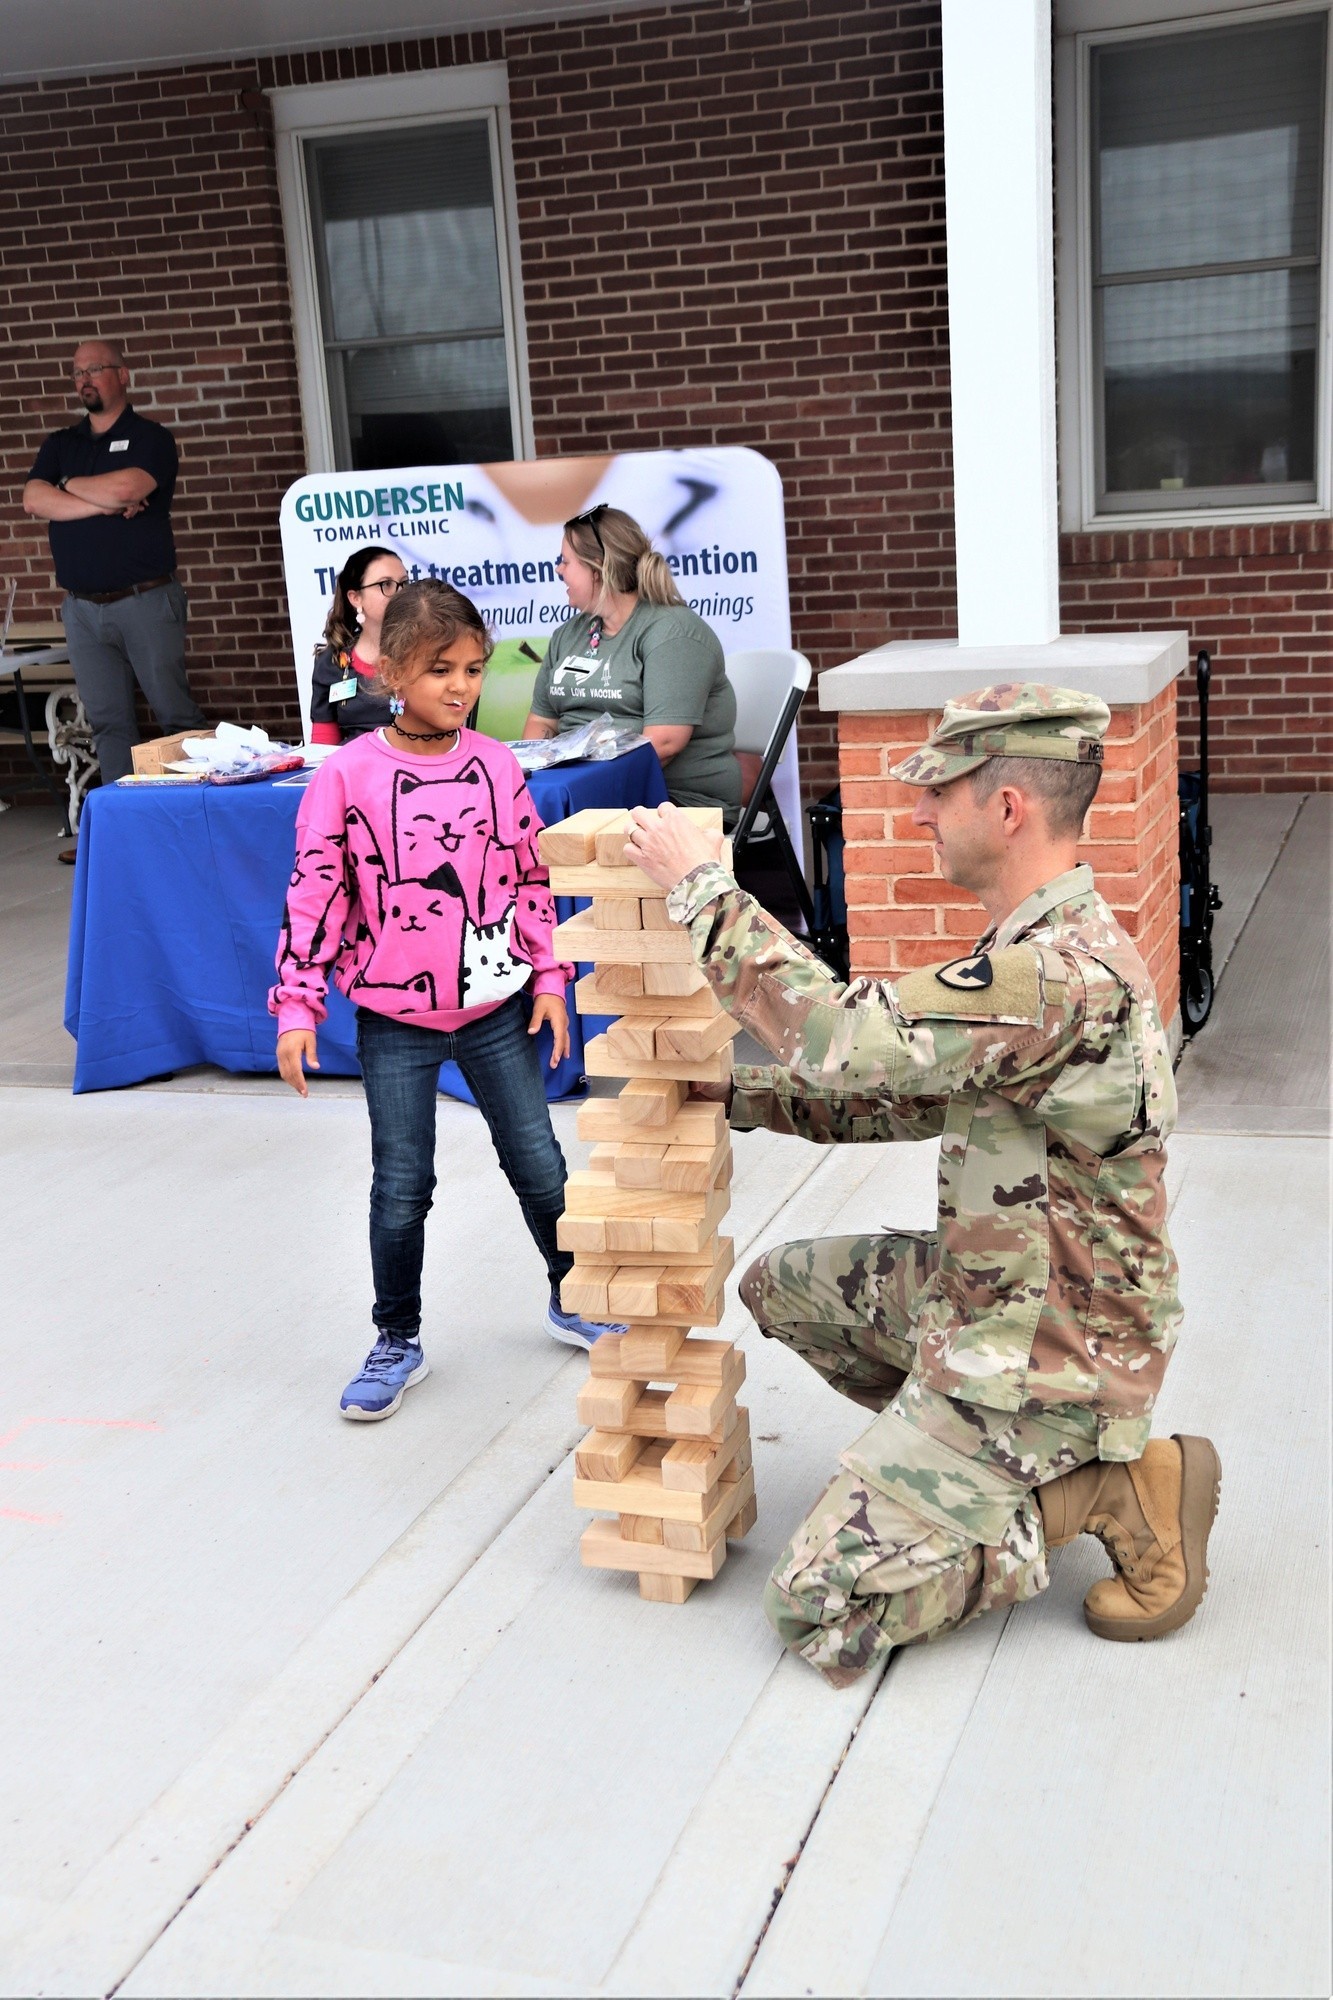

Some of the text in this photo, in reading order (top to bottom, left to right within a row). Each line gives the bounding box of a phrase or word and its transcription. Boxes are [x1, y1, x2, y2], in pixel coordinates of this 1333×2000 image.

[295, 482, 465, 522] GUNDERSEN
[313, 519, 450, 543] TOMAH CLINIC
[314, 566, 338, 596] Th
[665, 544, 758, 577] ention
[481, 599, 534, 626] nnual
[689, 592, 754, 622] enings
[589, 688, 622, 700] VACCINE
